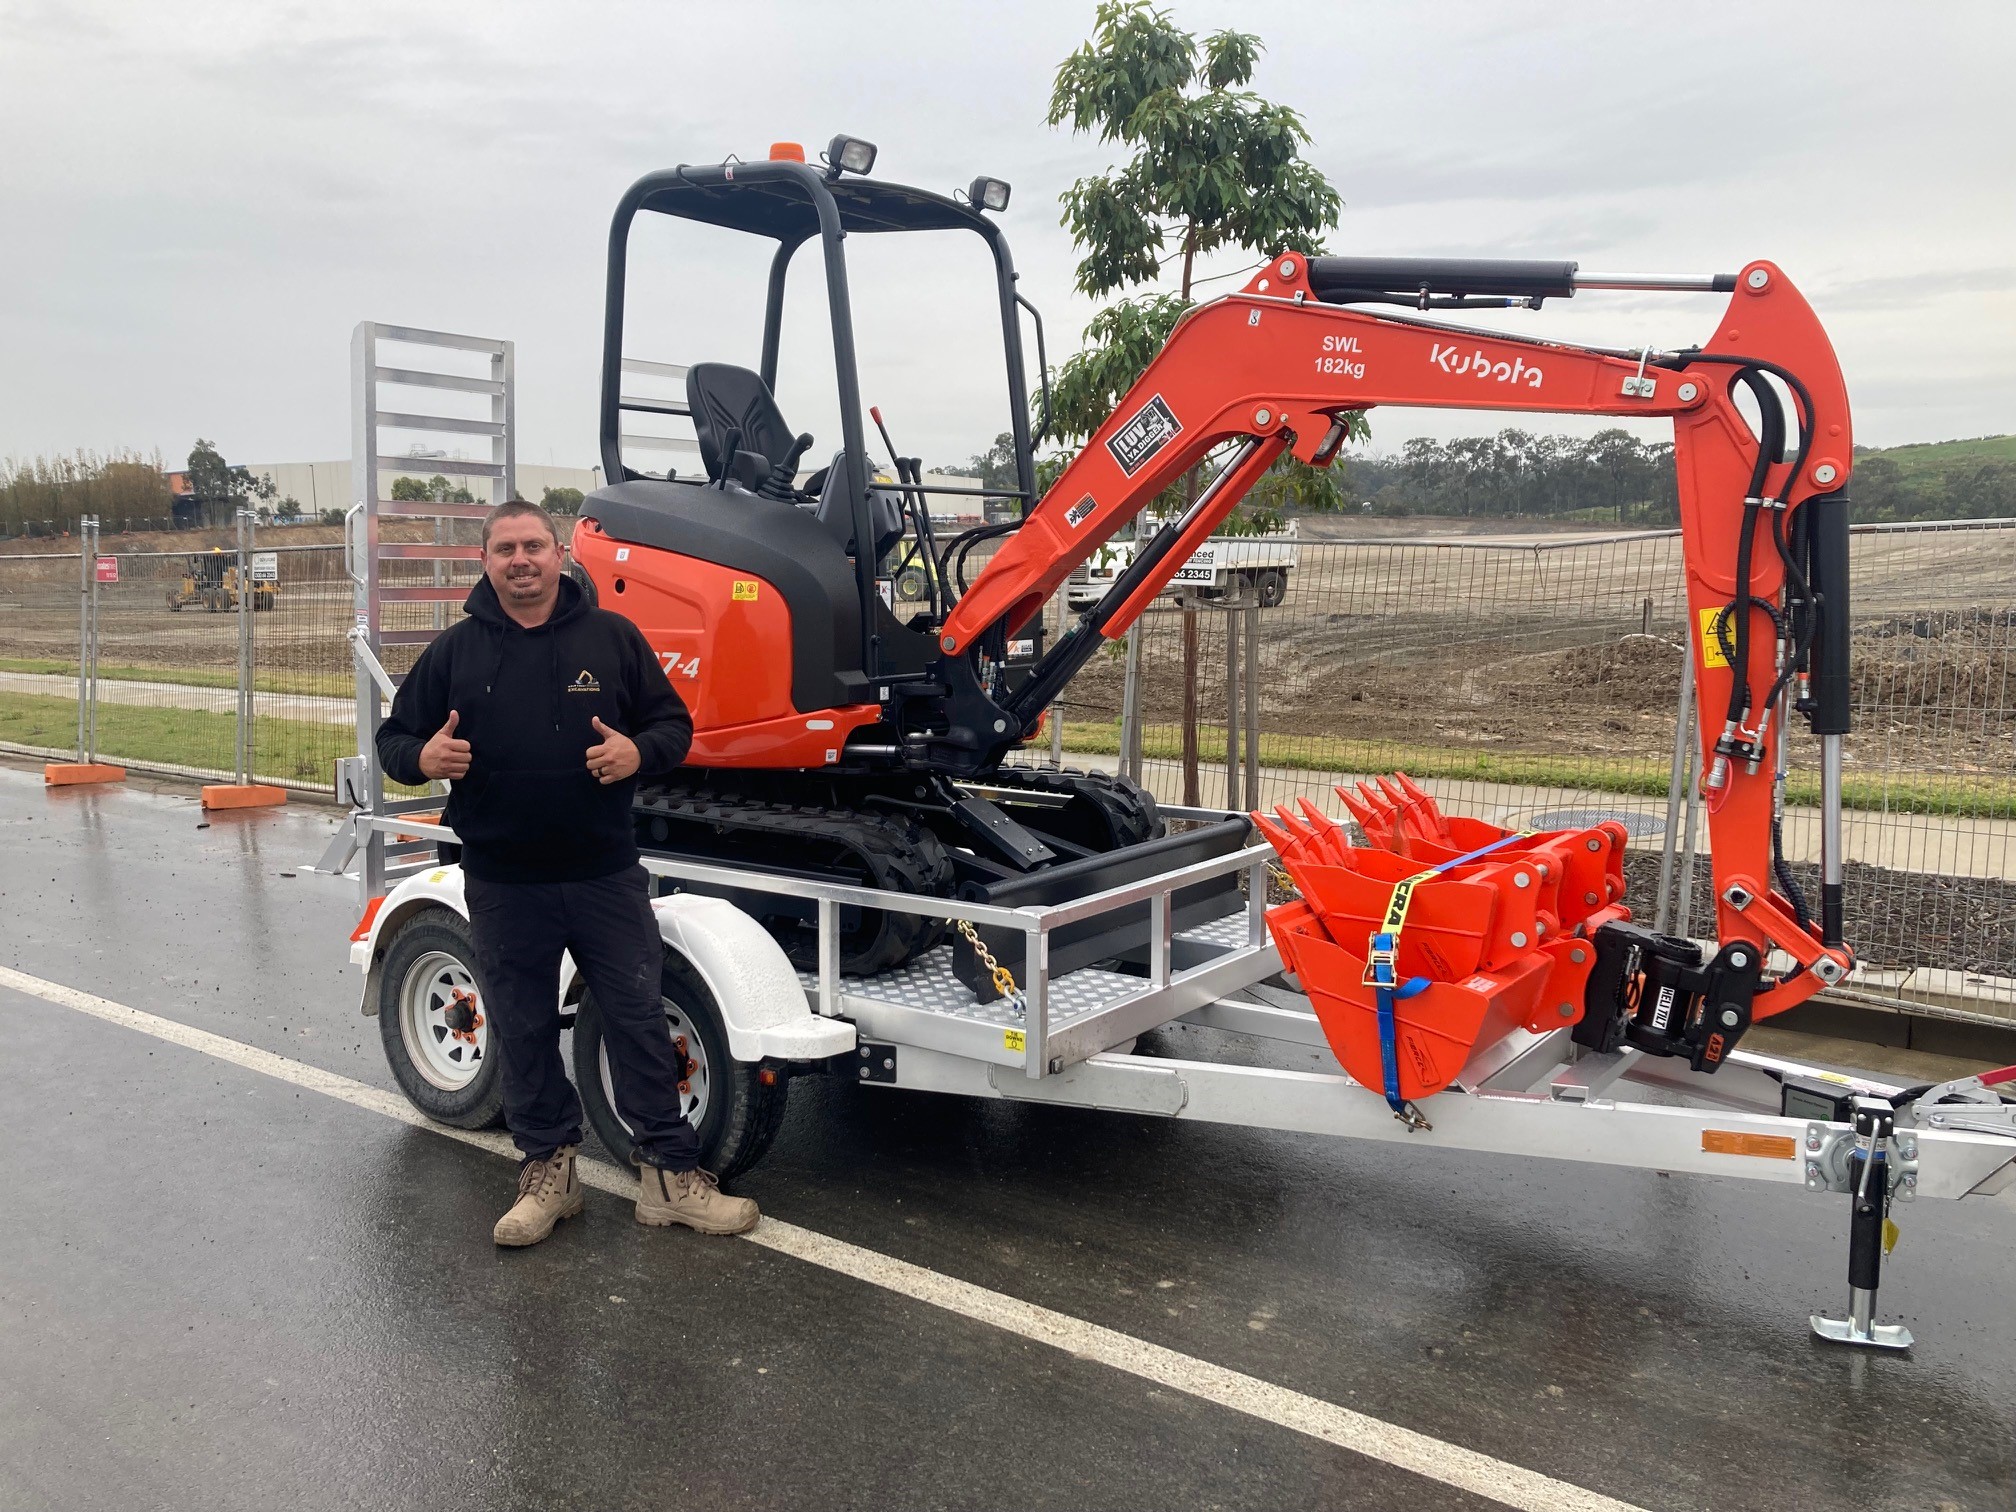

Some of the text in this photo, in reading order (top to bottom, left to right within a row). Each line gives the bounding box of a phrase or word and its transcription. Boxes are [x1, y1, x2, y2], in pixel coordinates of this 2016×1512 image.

[1322, 336, 1362, 353] SWL
[1314, 357, 1365, 379] 182kg
[1430, 343, 1543, 388] Kubota
[1118, 421, 1147, 453] LUV
[1127, 448, 1139, 459] YA
[1187, 570, 1211, 579] 2345
[654, 651, 700, 678] 7-4
[1655, 987, 1674, 1028] HELI TILT
